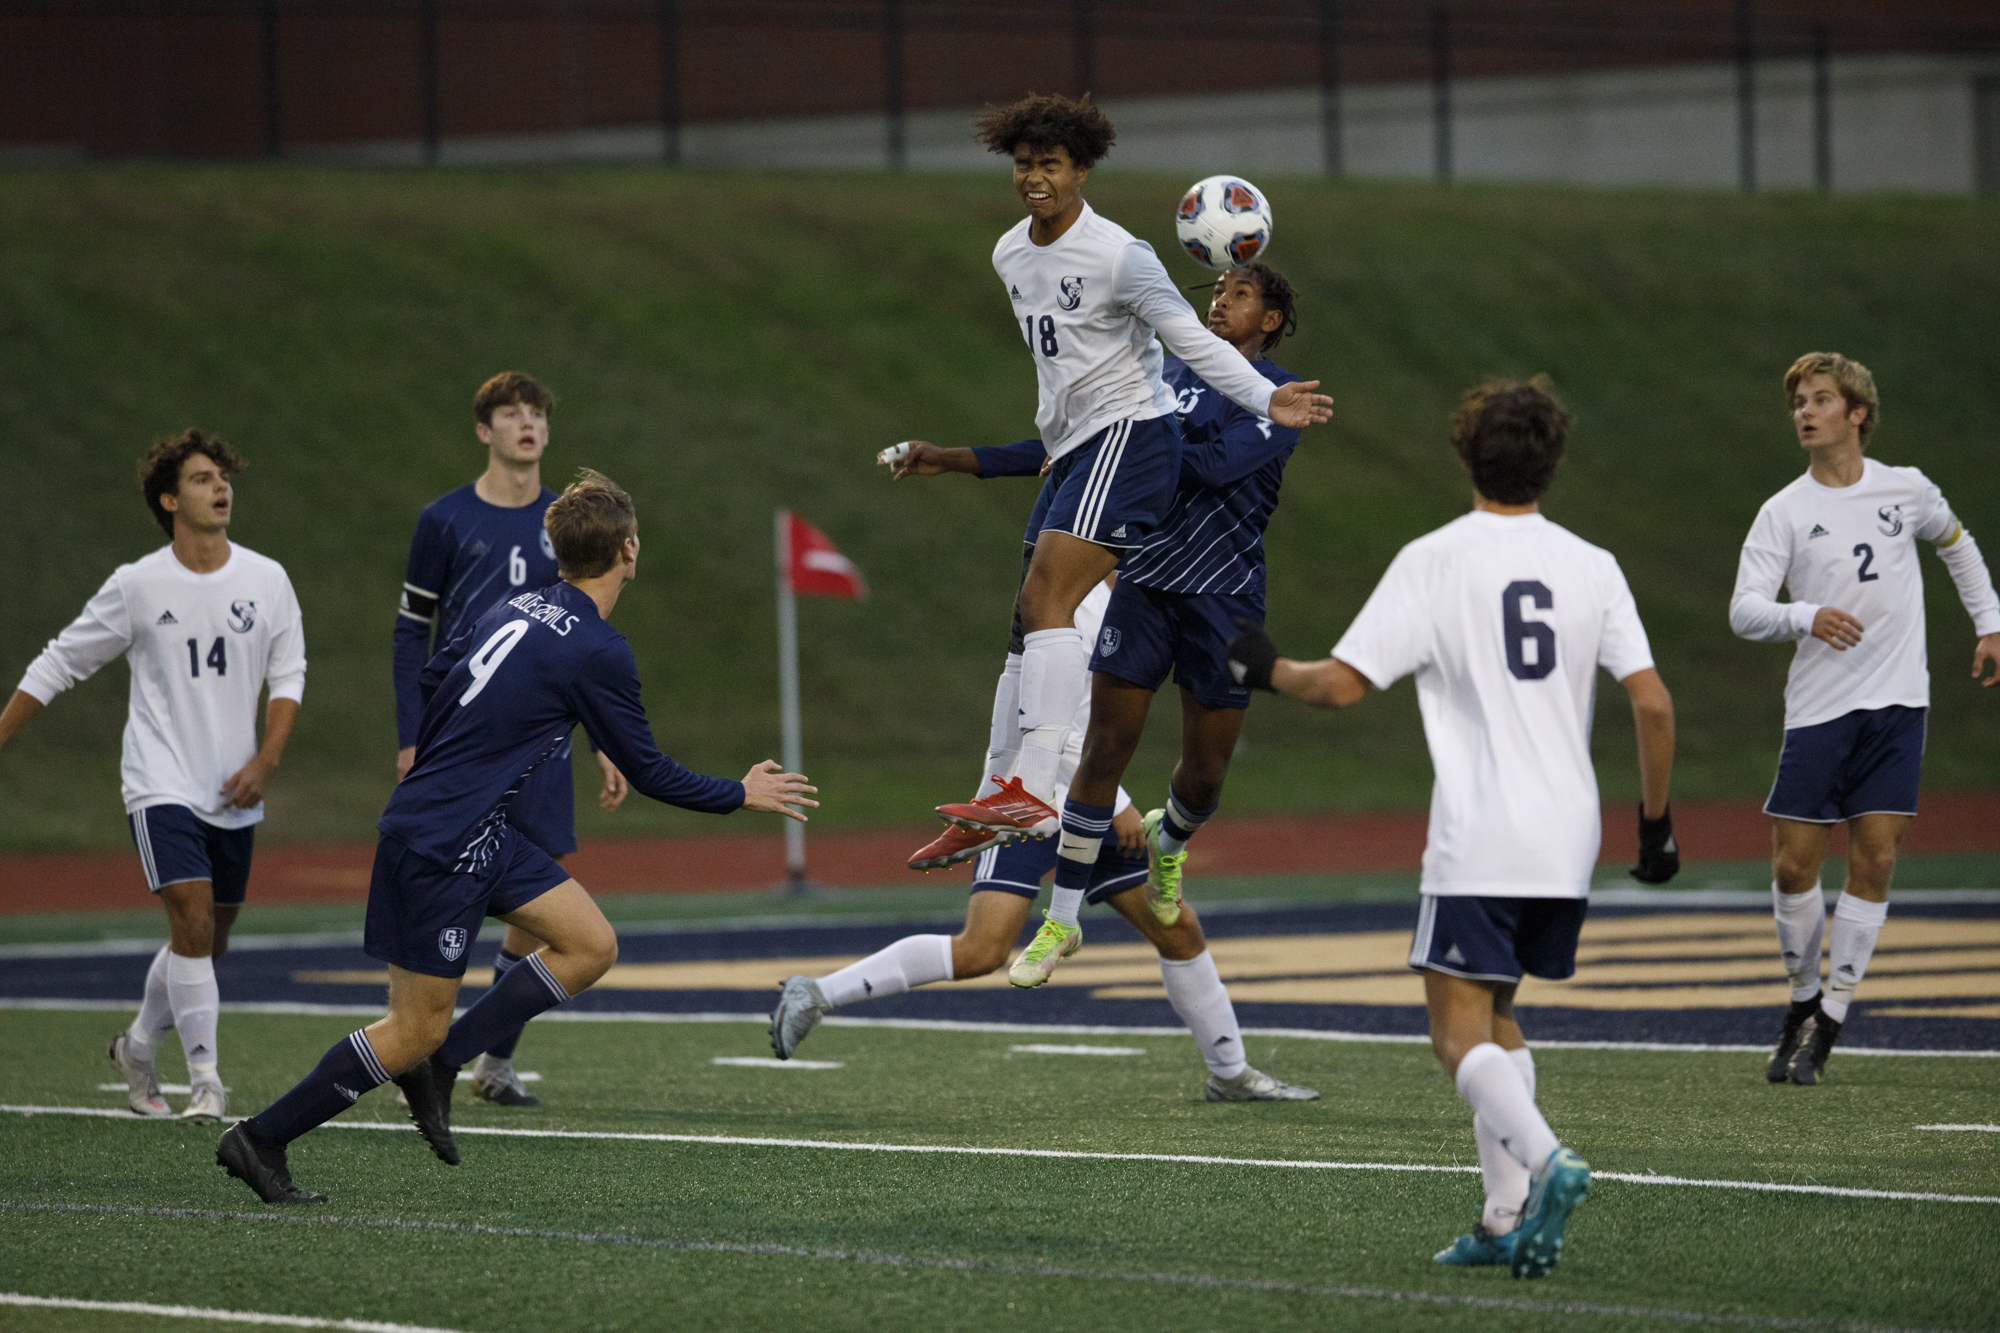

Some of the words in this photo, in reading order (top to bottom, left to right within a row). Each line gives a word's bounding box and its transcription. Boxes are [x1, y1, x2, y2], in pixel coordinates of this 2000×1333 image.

[1026, 314, 1059, 357] 18
[509, 545, 527, 587] 6
[1852, 543, 1879, 583] 2
[1502, 579, 1556, 681] 6
[186, 635, 227, 679] 14
[459, 618, 530, 708] 9
